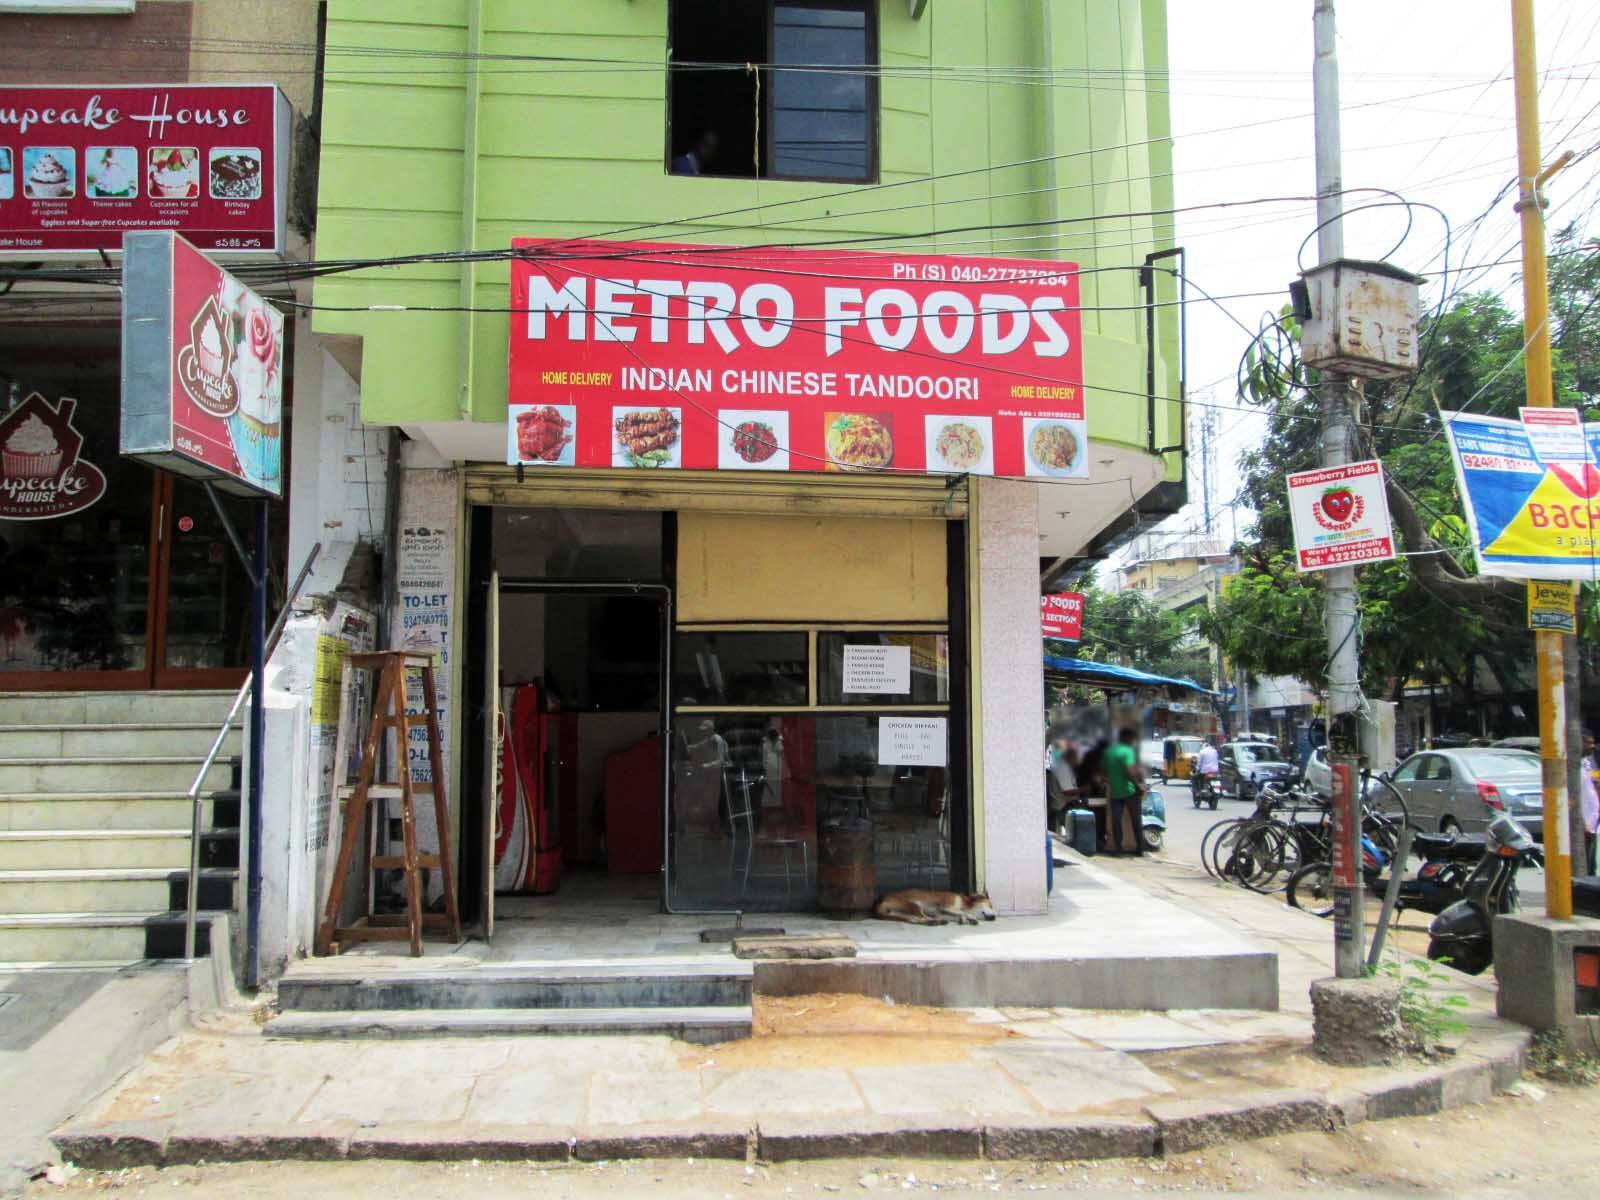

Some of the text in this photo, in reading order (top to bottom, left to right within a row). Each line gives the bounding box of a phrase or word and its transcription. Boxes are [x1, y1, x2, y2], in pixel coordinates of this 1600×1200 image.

[130, 93, 250, 139] House
[116, 219, 148, 227] Cupcakes
[16, 238, 43, 246] House
[893, 263, 916, 280] Ph
[527, 275, 1070, 358] METRO FOODS
[187, 355, 233, 399] Cupcake
[542, 371, 612, 386] HOME DELIVERY
[621, 367, 979, 401] INDIAN CHINESE TANDOORI
[1011, 385, 1075, 401] HOME DELIVERY
[1291, 464, 1376, 486] Strawberry Fields
[16, 491, 57, 503] HOUSE
[404, 595, 448, 608] TO-LET
[1049, 596, 1081, 611] FOODS
